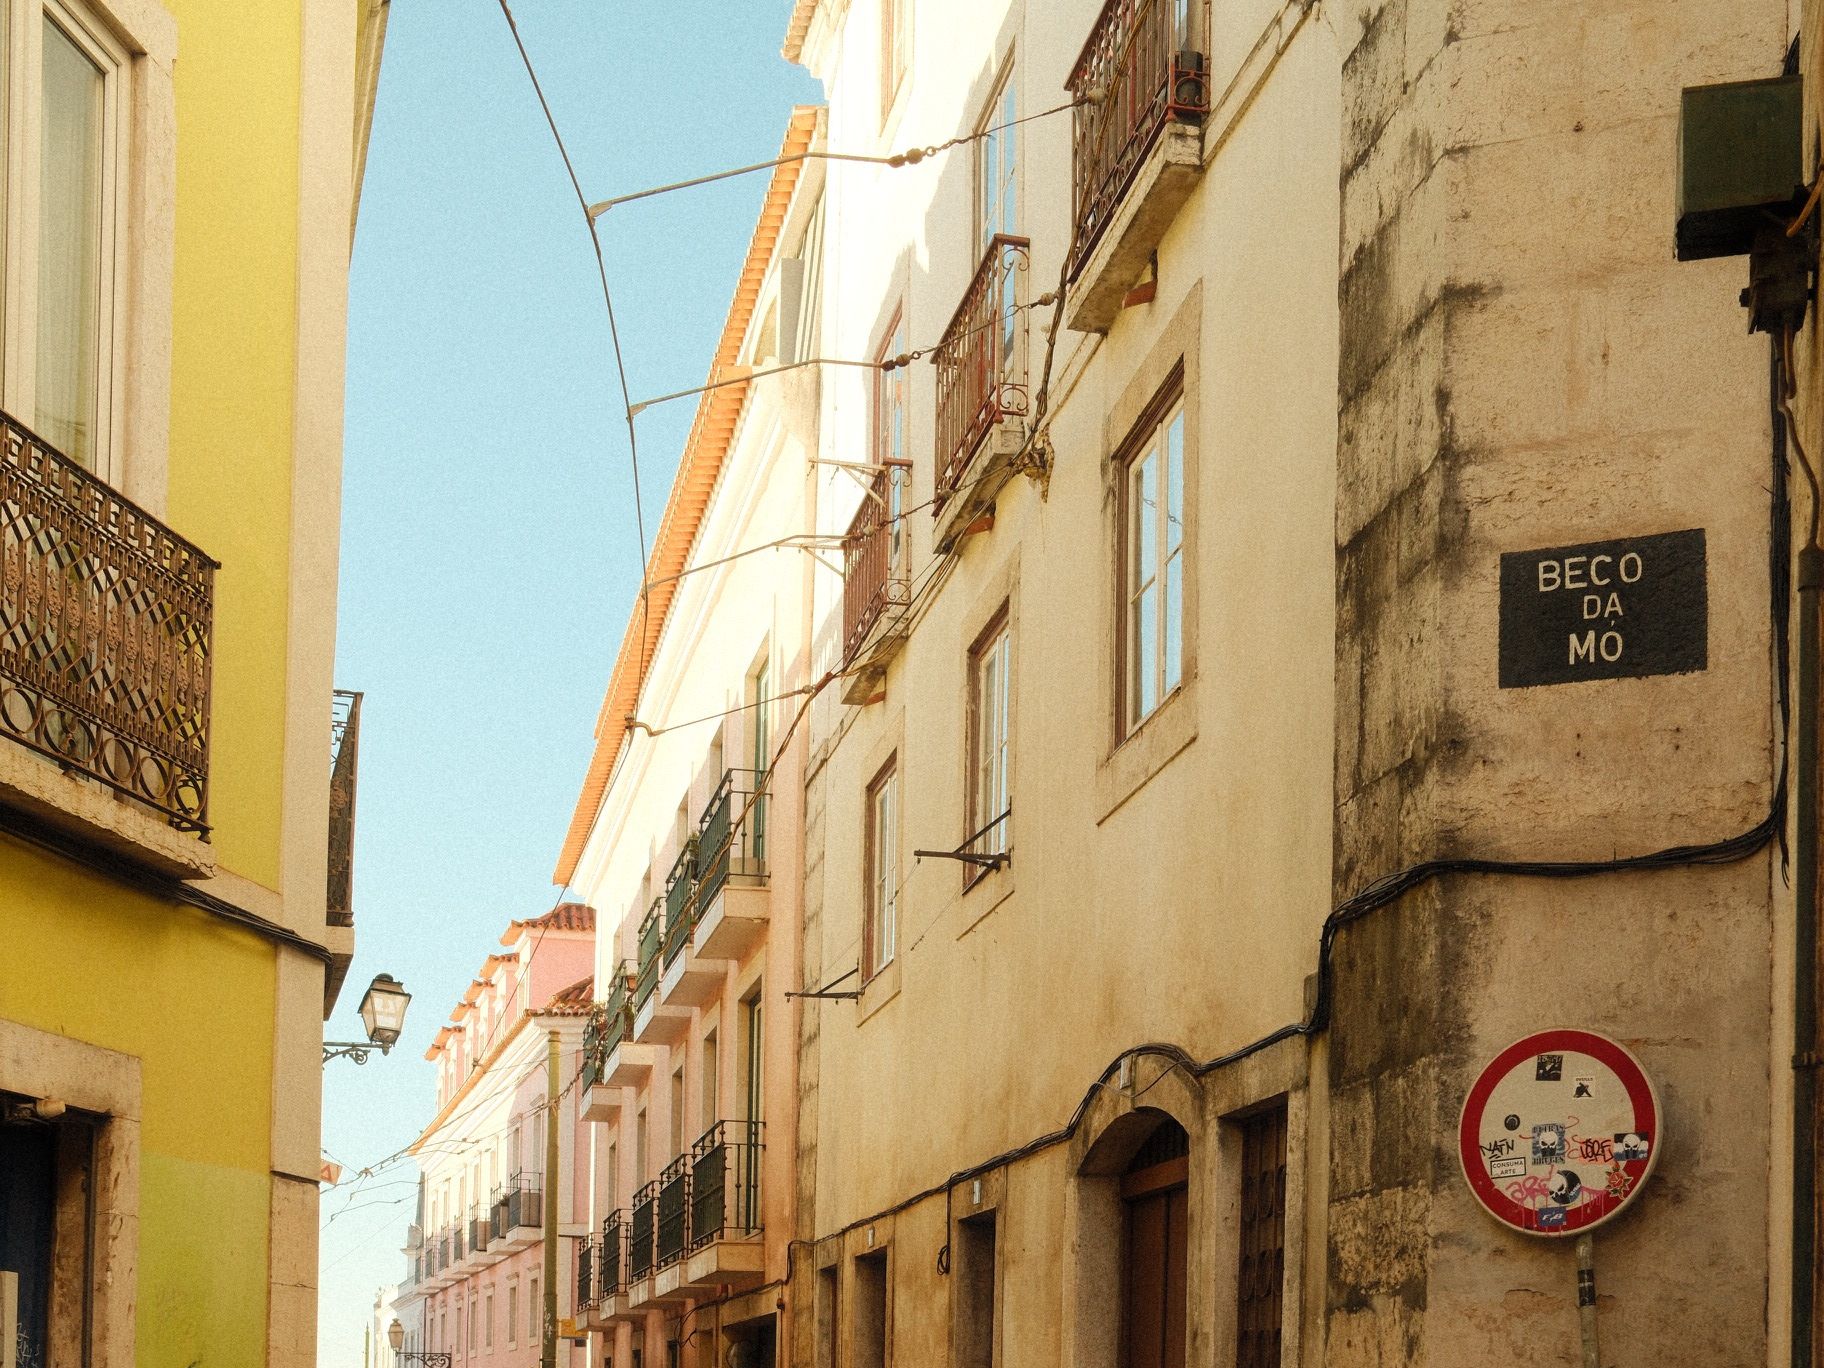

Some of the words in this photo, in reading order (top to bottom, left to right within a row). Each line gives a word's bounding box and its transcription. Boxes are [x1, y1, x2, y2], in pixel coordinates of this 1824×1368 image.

[1538, 552, 1643, 592] BECO
[1583, 592, 1624, 620] DA
[1568, 620, 1623, 665] MÓ
[1492, 1160, 1524, 1169] CONSUMA
